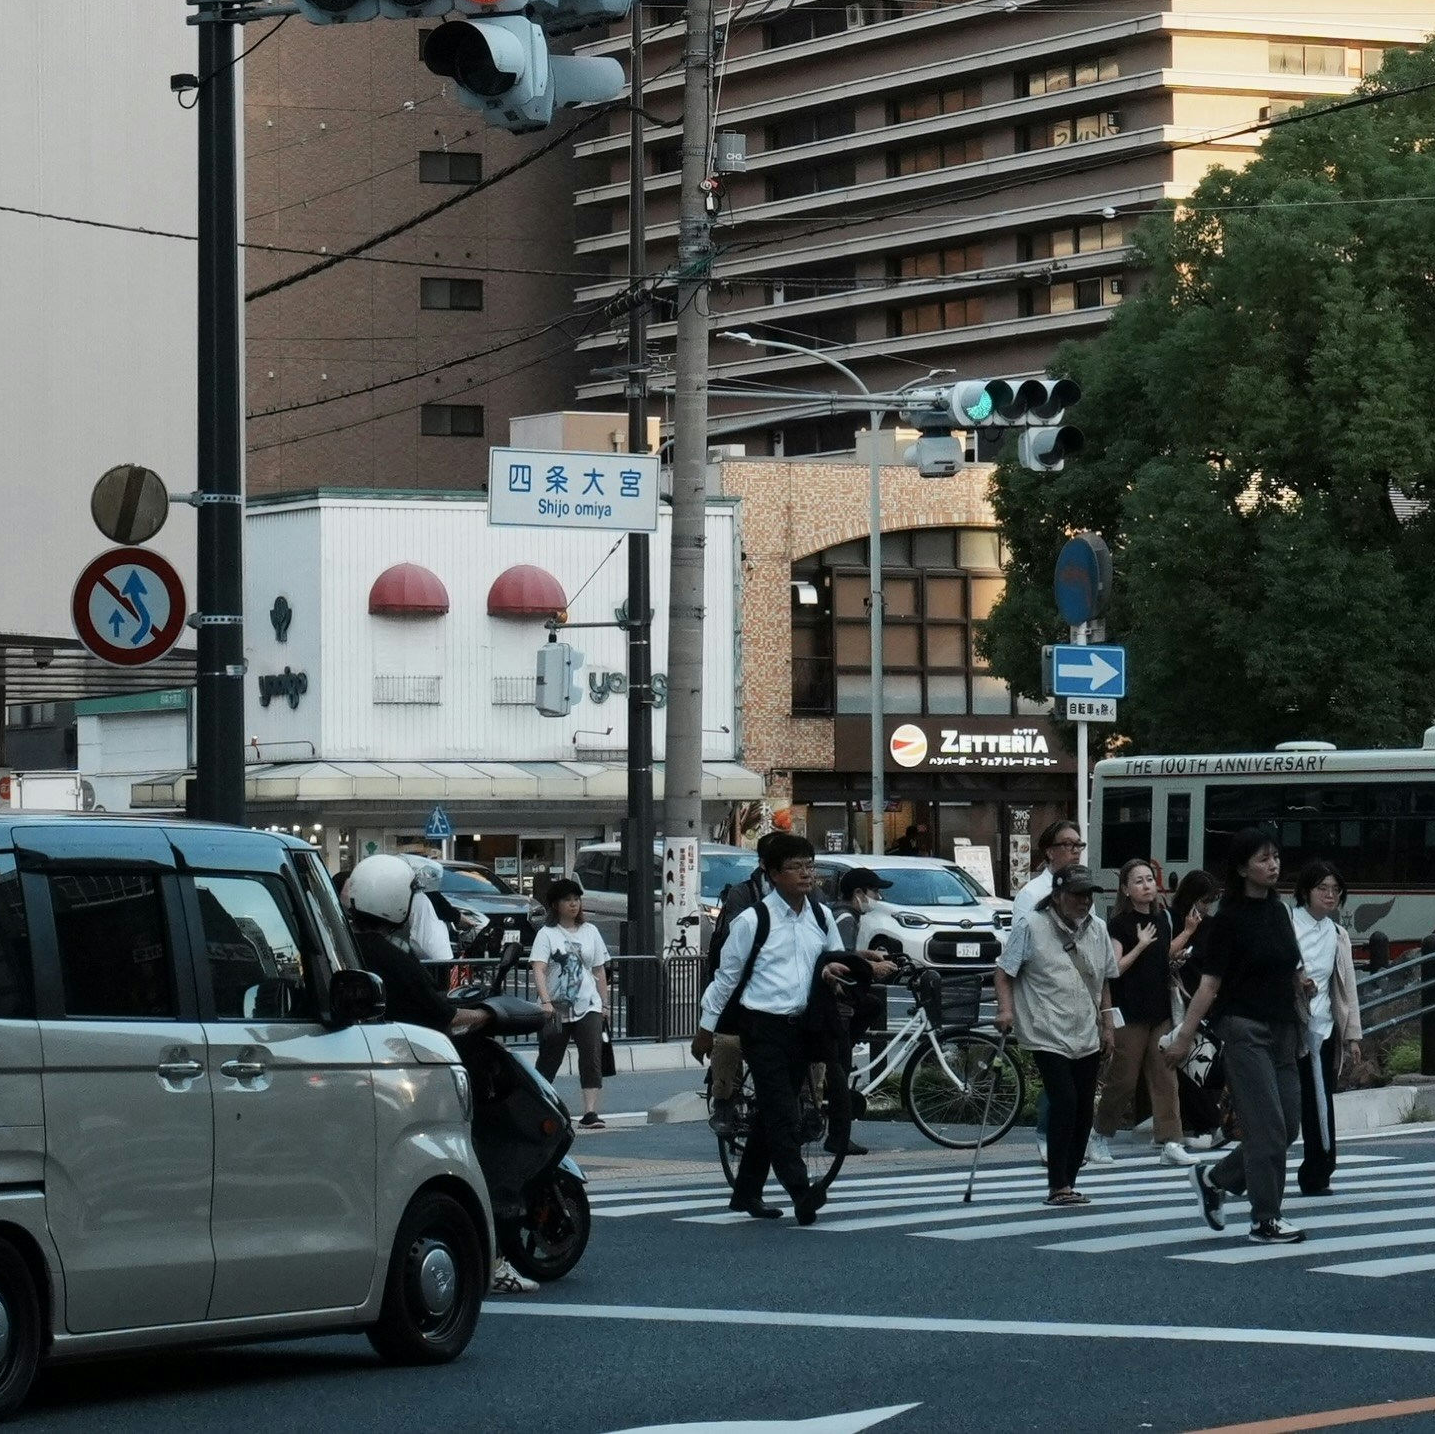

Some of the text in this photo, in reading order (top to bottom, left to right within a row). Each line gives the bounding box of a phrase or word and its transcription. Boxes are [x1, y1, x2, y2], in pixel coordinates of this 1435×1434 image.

[508, 464, 642, 498] 四条大宮
[538, 498, 612, 519] Shijo omiya
[1069, 702, 1115, 716] 自転車を除く
[1125, 755, 1327, 774] THE 100TH ANNIVERSARY
